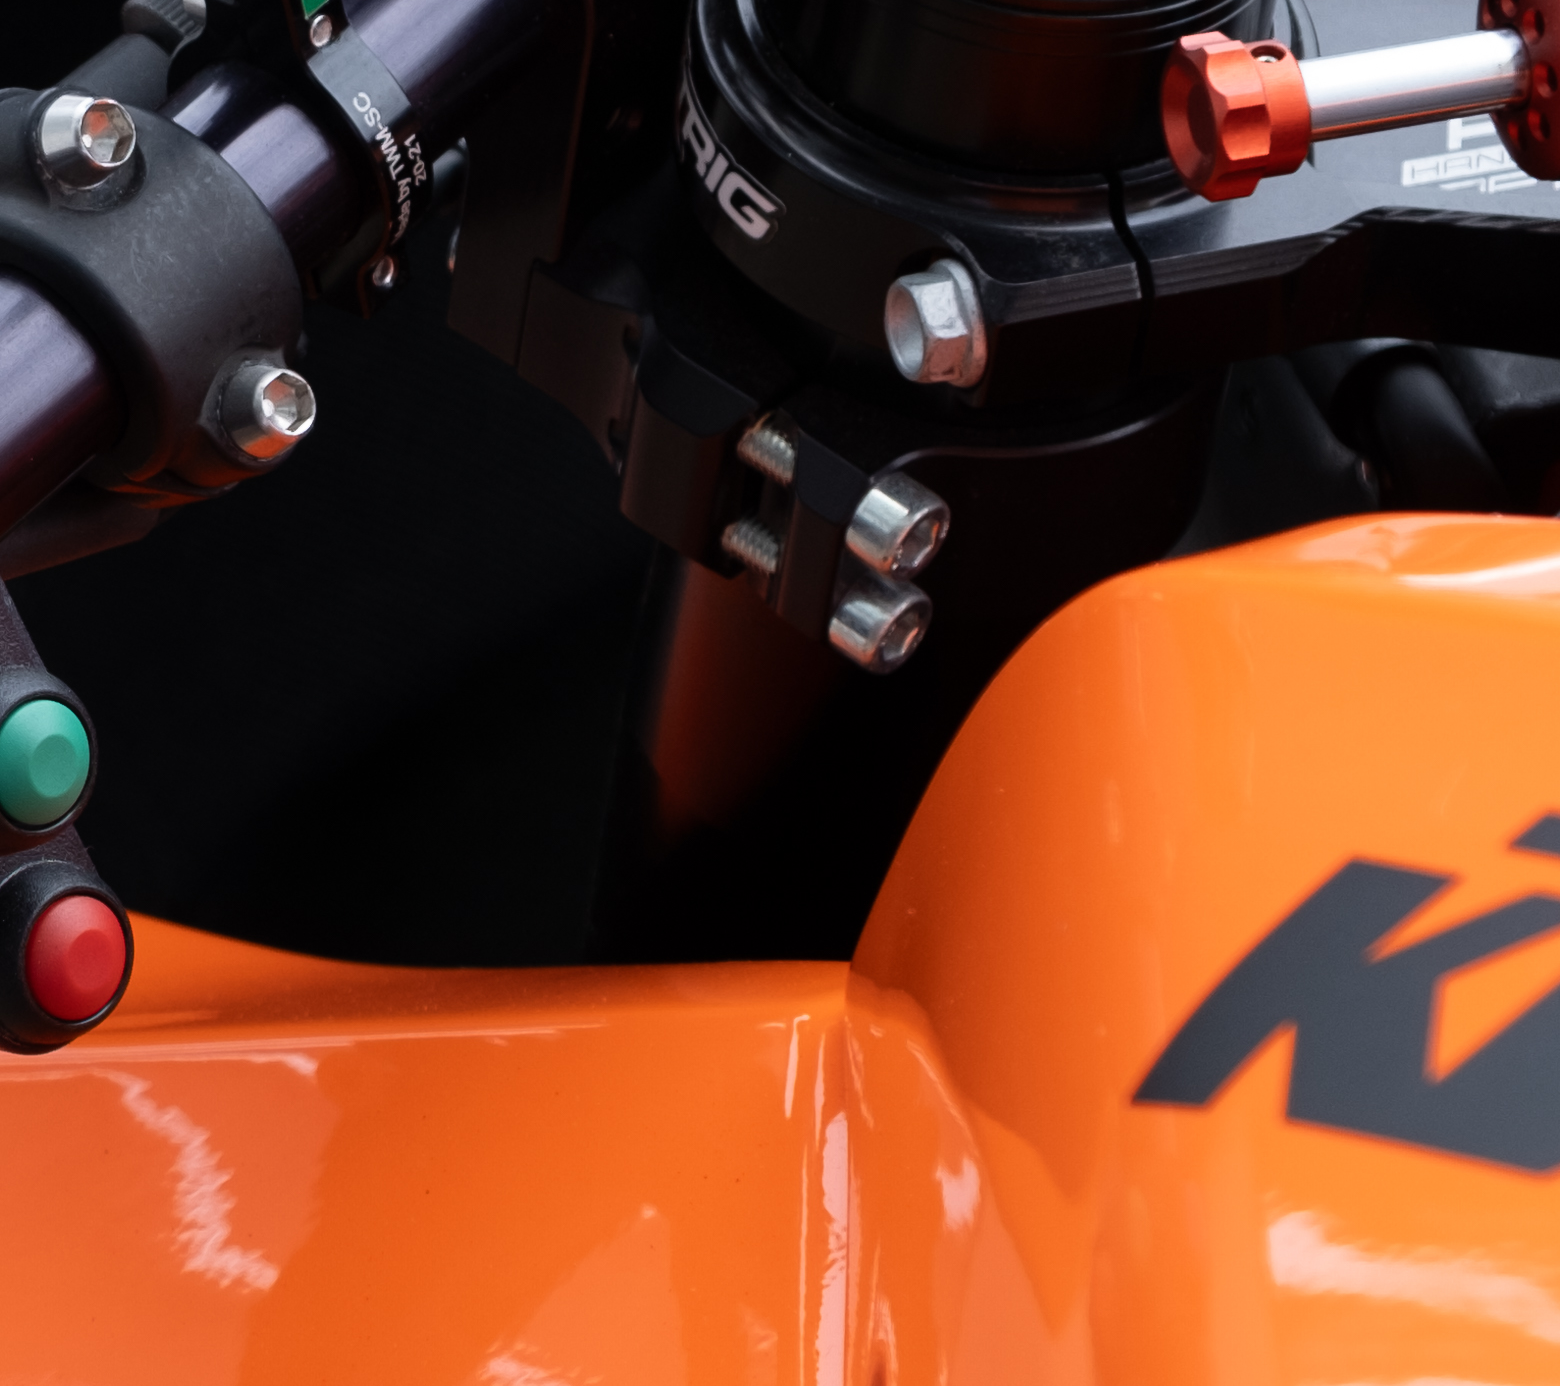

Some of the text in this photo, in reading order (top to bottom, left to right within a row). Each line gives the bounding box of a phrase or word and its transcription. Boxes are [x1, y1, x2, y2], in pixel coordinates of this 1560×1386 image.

[352, 92, 405, 181] TWM-SC
[403, 133, 427, 186] 20-21
[397, 176, 412, 204] by
